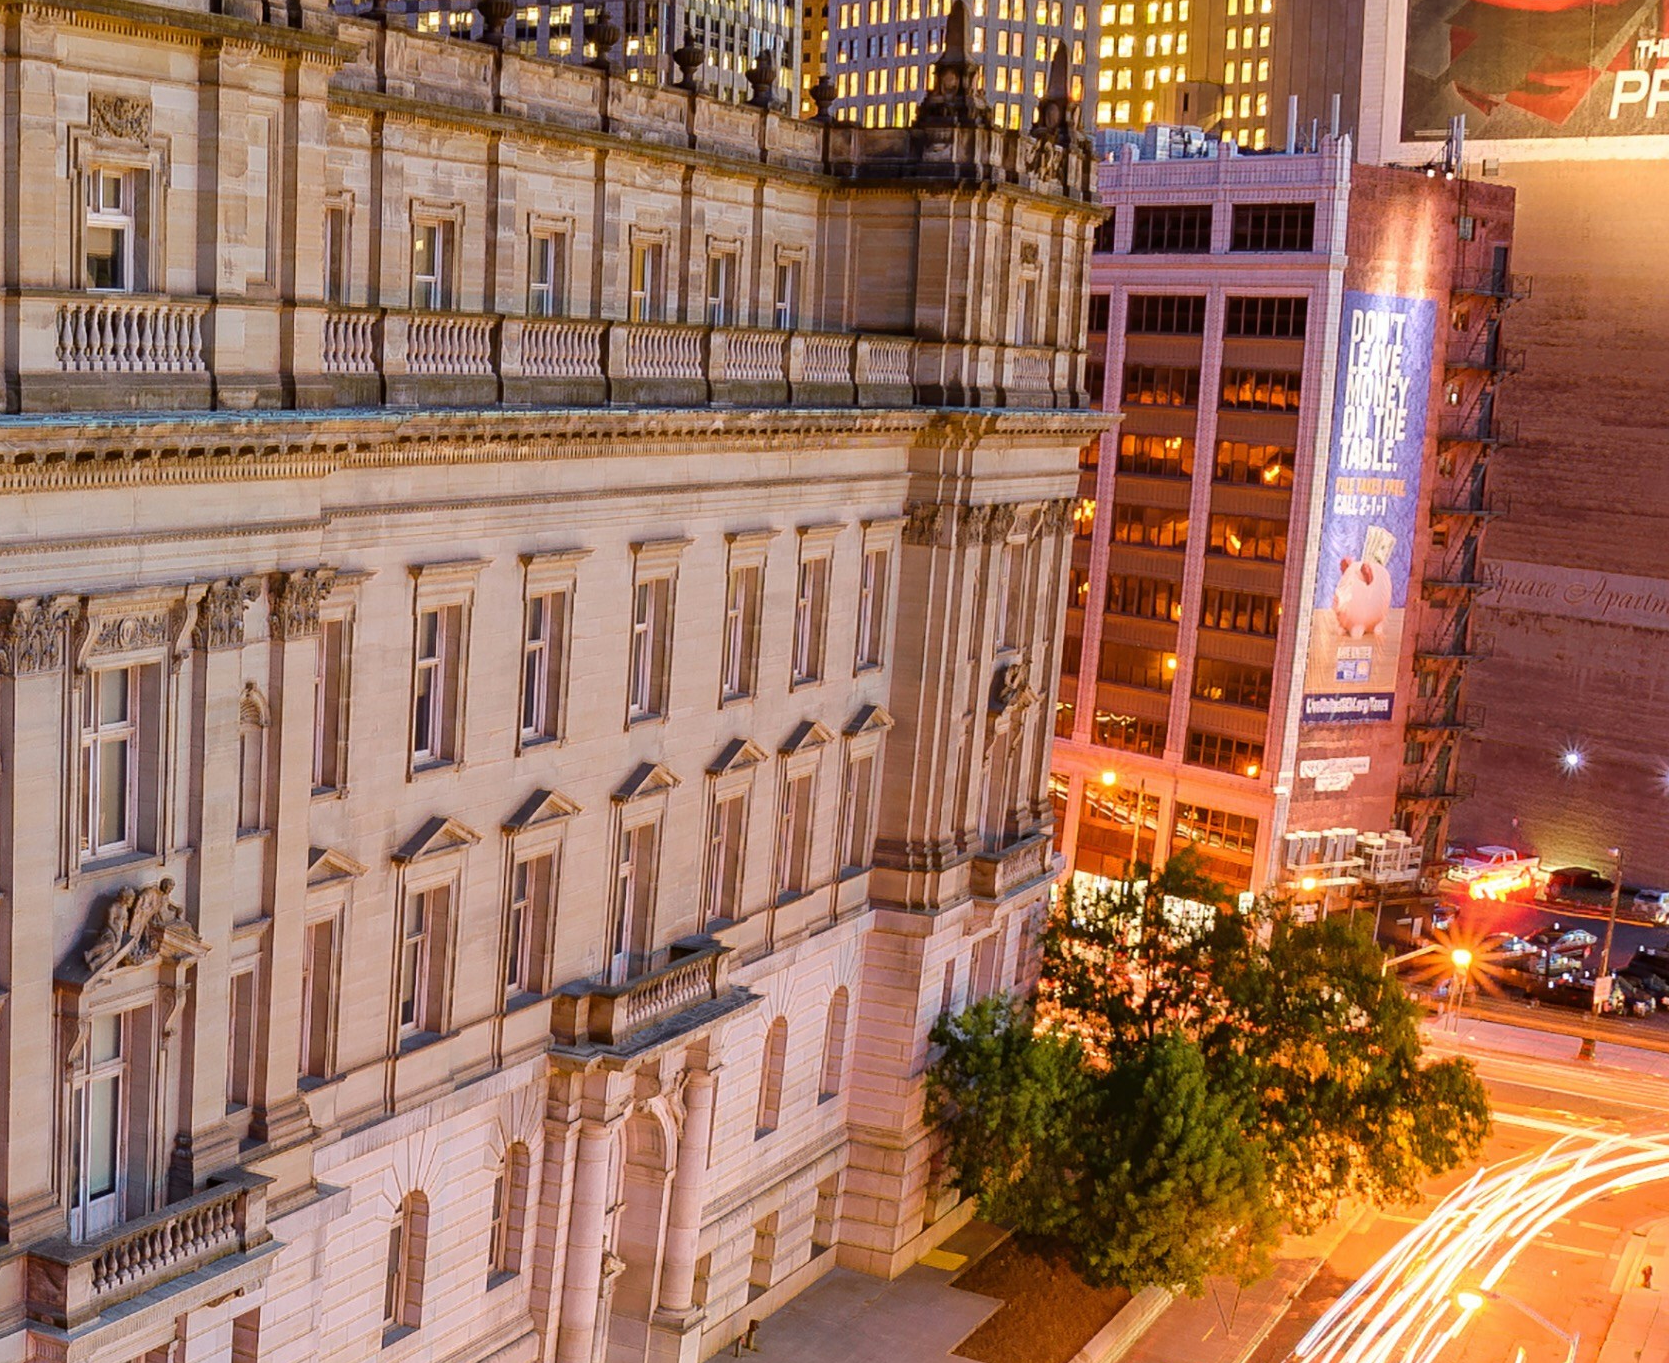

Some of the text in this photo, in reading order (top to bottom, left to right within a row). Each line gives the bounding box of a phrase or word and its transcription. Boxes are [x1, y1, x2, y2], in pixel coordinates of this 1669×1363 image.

[1351, 309, 1406, 345] DON'T
[1348, 340, 1404, 378] LEAVE
[1345, 374, 1410, 409] MONEY
[1342, 405, 1408, 440] ON THE
[1340, 436, 1398, 472] TABLE.
[1333, 494, 1387, 516] CALL 2-1-1
